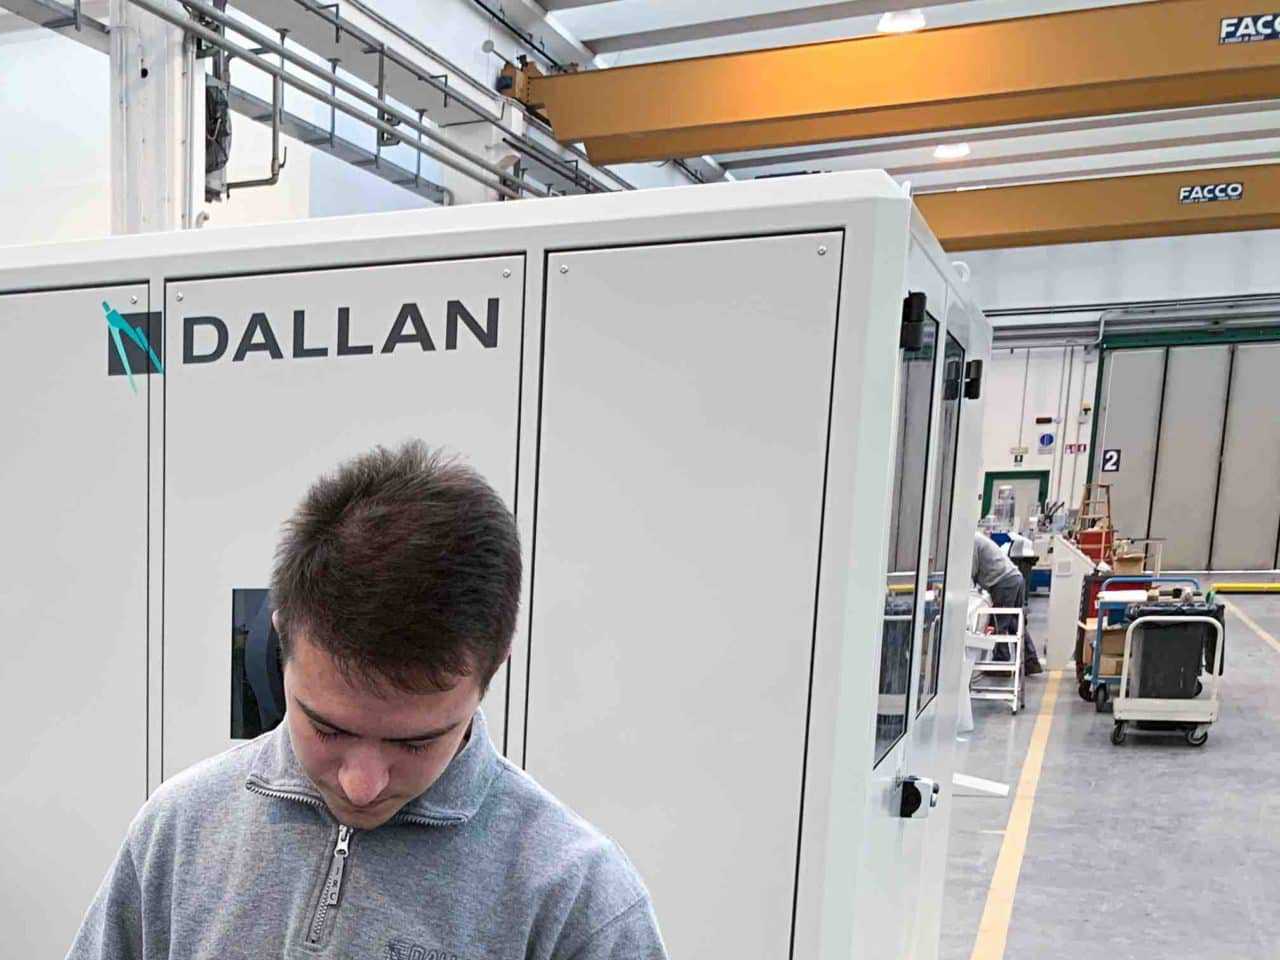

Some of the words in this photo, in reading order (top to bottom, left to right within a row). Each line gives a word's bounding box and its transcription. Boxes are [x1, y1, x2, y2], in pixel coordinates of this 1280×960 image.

[1180, 184, 1243, 200] FACCO
[182, 297, 500, 365] DALLAN
[1104, 450, 1119, 471] 2
